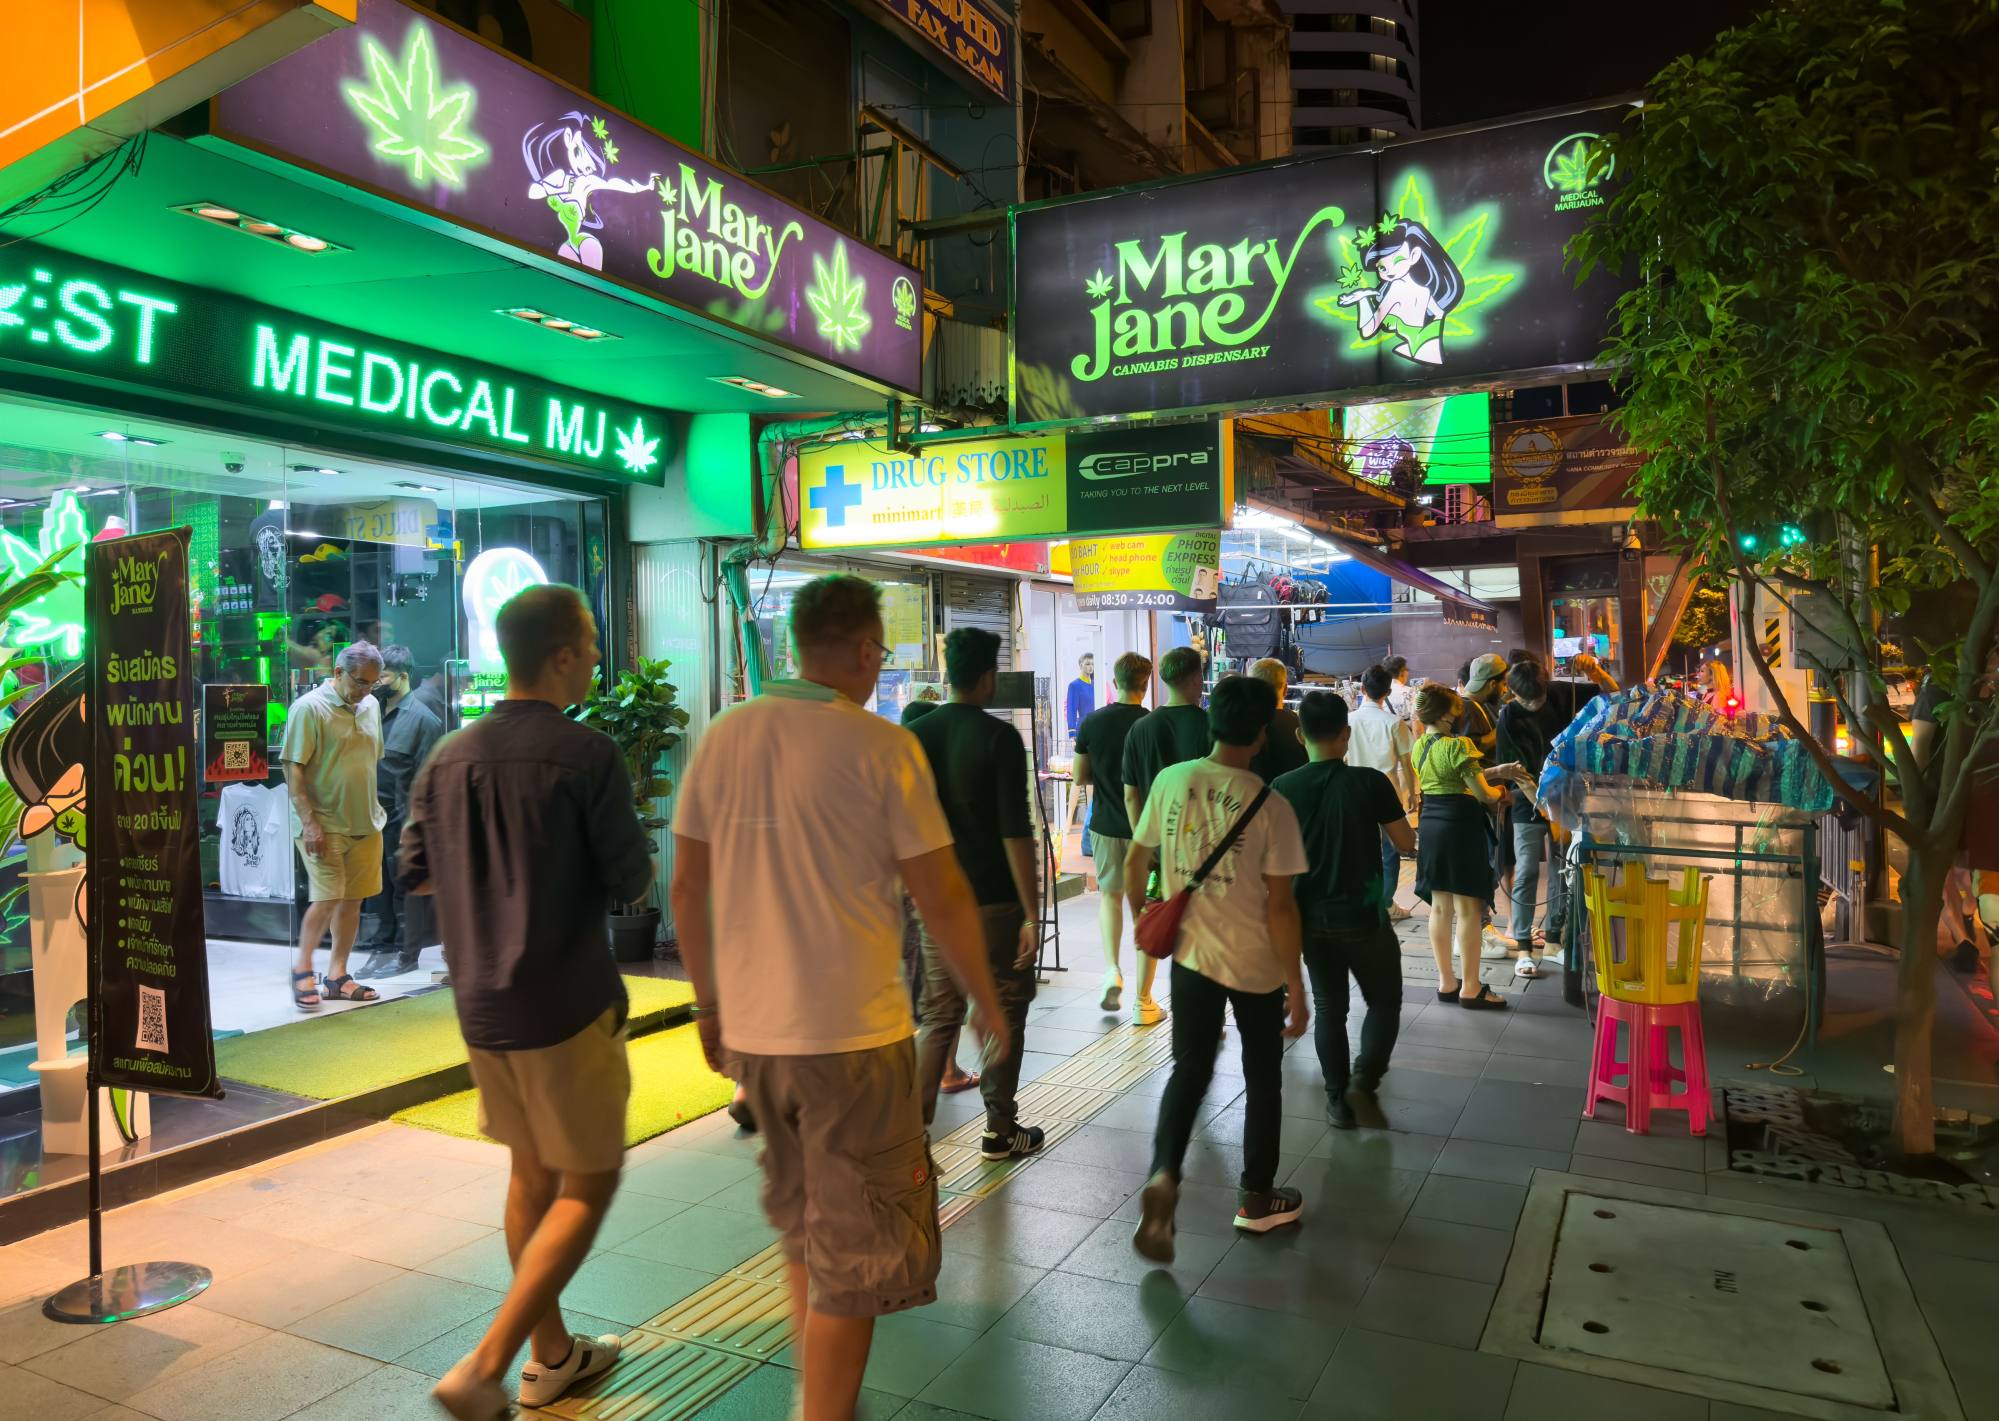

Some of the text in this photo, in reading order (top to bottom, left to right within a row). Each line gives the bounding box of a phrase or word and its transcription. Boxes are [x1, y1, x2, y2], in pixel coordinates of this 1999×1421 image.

[955, 36, 1004, 92] SCAN
[1560, 190, 1598, 202] MEDICAL
[677, 162, 804, 262] Mary
[1114, 206, 1345, 308] Mary
[1113, 346, 1270, 377] CANNABIS DISPENSARY
[253, 325, 530, 443] MEDICAL
[546, 398, 606, 459] MJ
[872, 447, 1048, 491] DRUG STORE
[1080, 481, 1209, 499] TAKING YOU TO THE NEXT LEVEL
[872, 506, 943, 524] minimart
[1079, 544, 1098, 558] BAHT
[1110, 541, 1145, 550] web cam
[1178, 539, 1216, 552] PHOTO
[118, 550, 168, 584] Mary
[1109, 552, 1157, 564] head phone
[1167, 551, 1216, 565] EXPRESS
[1079, 564, 1100, 576] HOUR
[1109, 567, 1130, 576] skype
[1086, 594, 1100, 609] daily
[1101, 593, 1127, 606] 08:30
[1137, 593, 1175, 606] 24:00
[107, 650, 176, 683] รับสมัคร
[107, 695, 183, 727] พนักงาน
[114, 737, 186, 793] ด่วน!
[134, 814, 148, 831] 20
